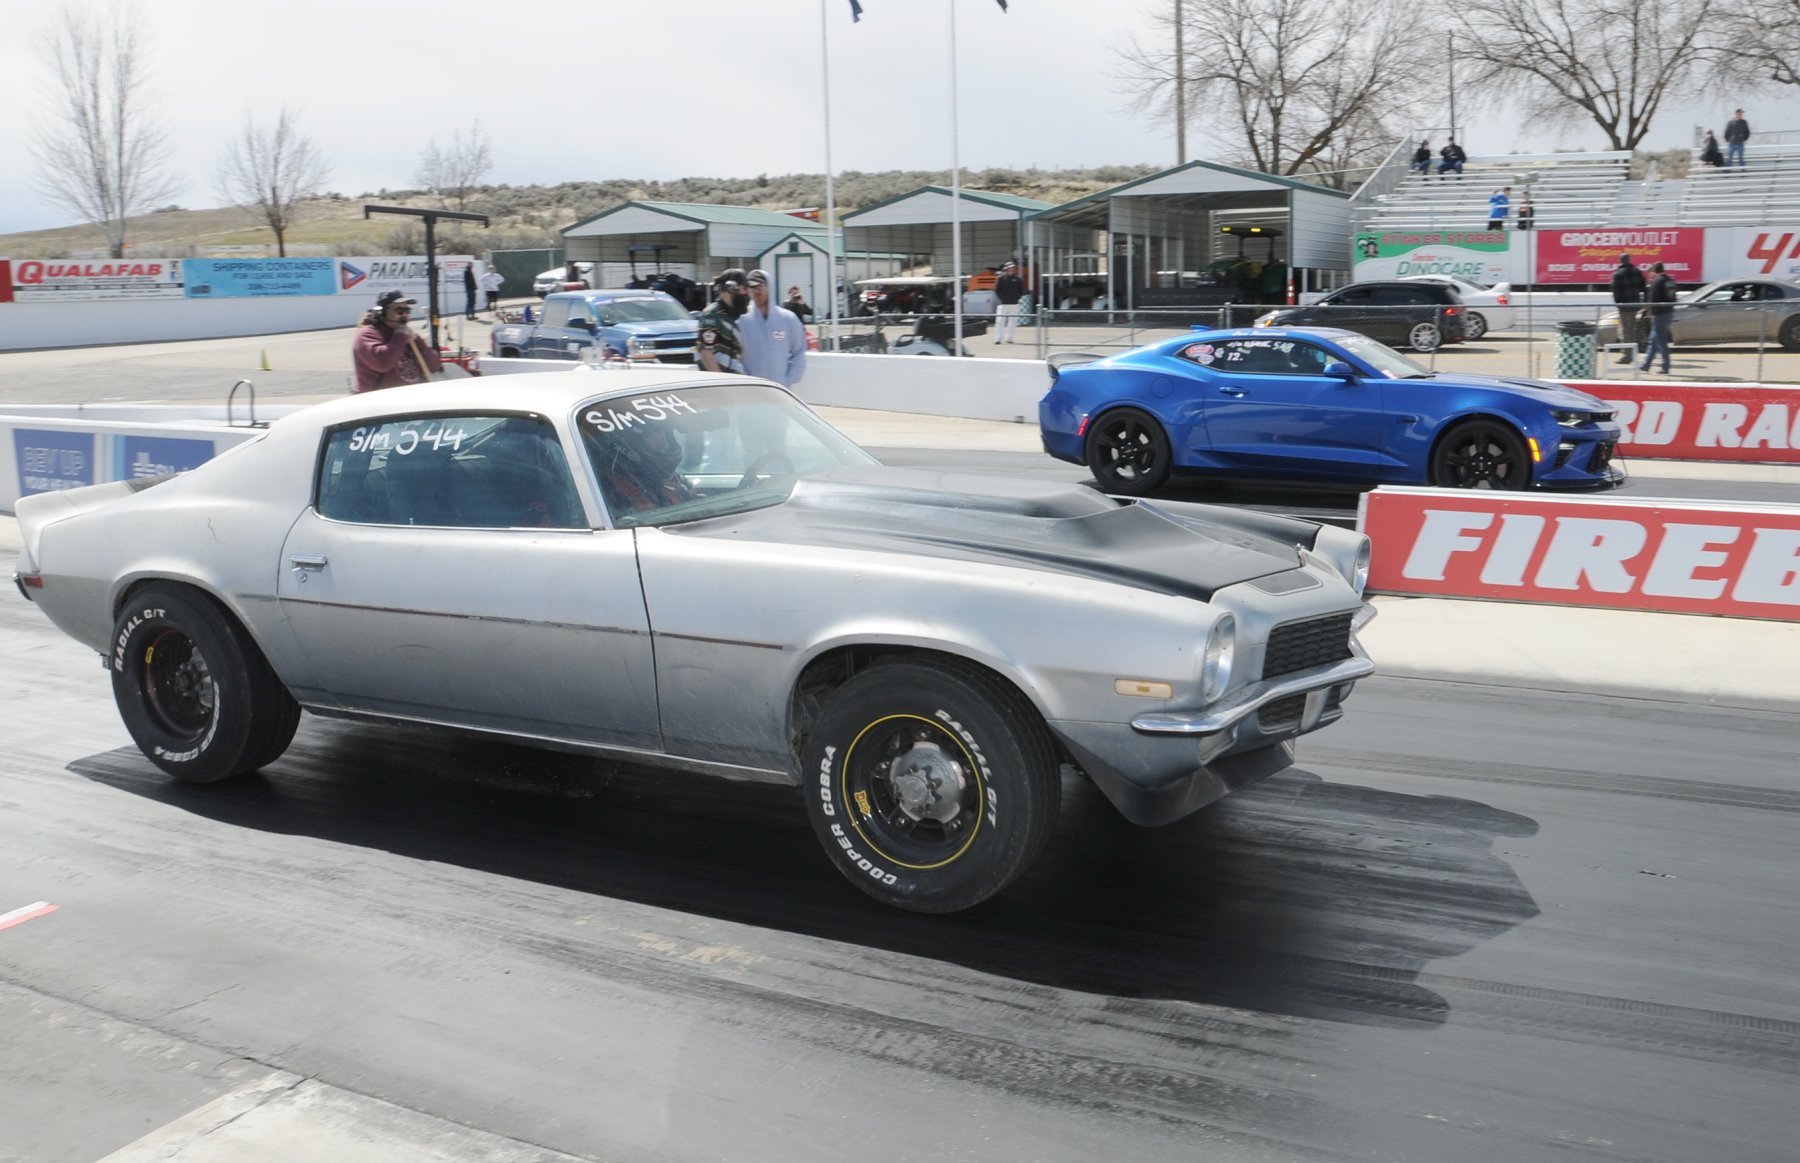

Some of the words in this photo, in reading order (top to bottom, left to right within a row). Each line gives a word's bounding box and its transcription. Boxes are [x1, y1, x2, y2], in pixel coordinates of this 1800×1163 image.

[1447, 233, 1505, 244] STORES
[16, 261, 162, 284] QUALAFAB
[212, 262, 263, 271] SHIPPING
[266, 261, 330, 270] CONTAINERS
[1396, 261, 1485, 275] DINOCARE
[1547, 263, 1576, 271] BOISE
[1581, 263, 1620, 271] OVERLA
[630, 394, 698, 422] 544
[349, 425, 390, 453] S/M
[395, 420, 468, 455] 544
[1695, 402, 1800, 450] RA
[1401, 509, 1800, 605] FIREB
[115, 616, 143, 672] RADIAL
[143, 608, 167, 619] G/T
[934, 709, 992, 783] RADIAL
[819, 745, 837, 817] COBRA
[830, 823, 898, 886] COOPER
